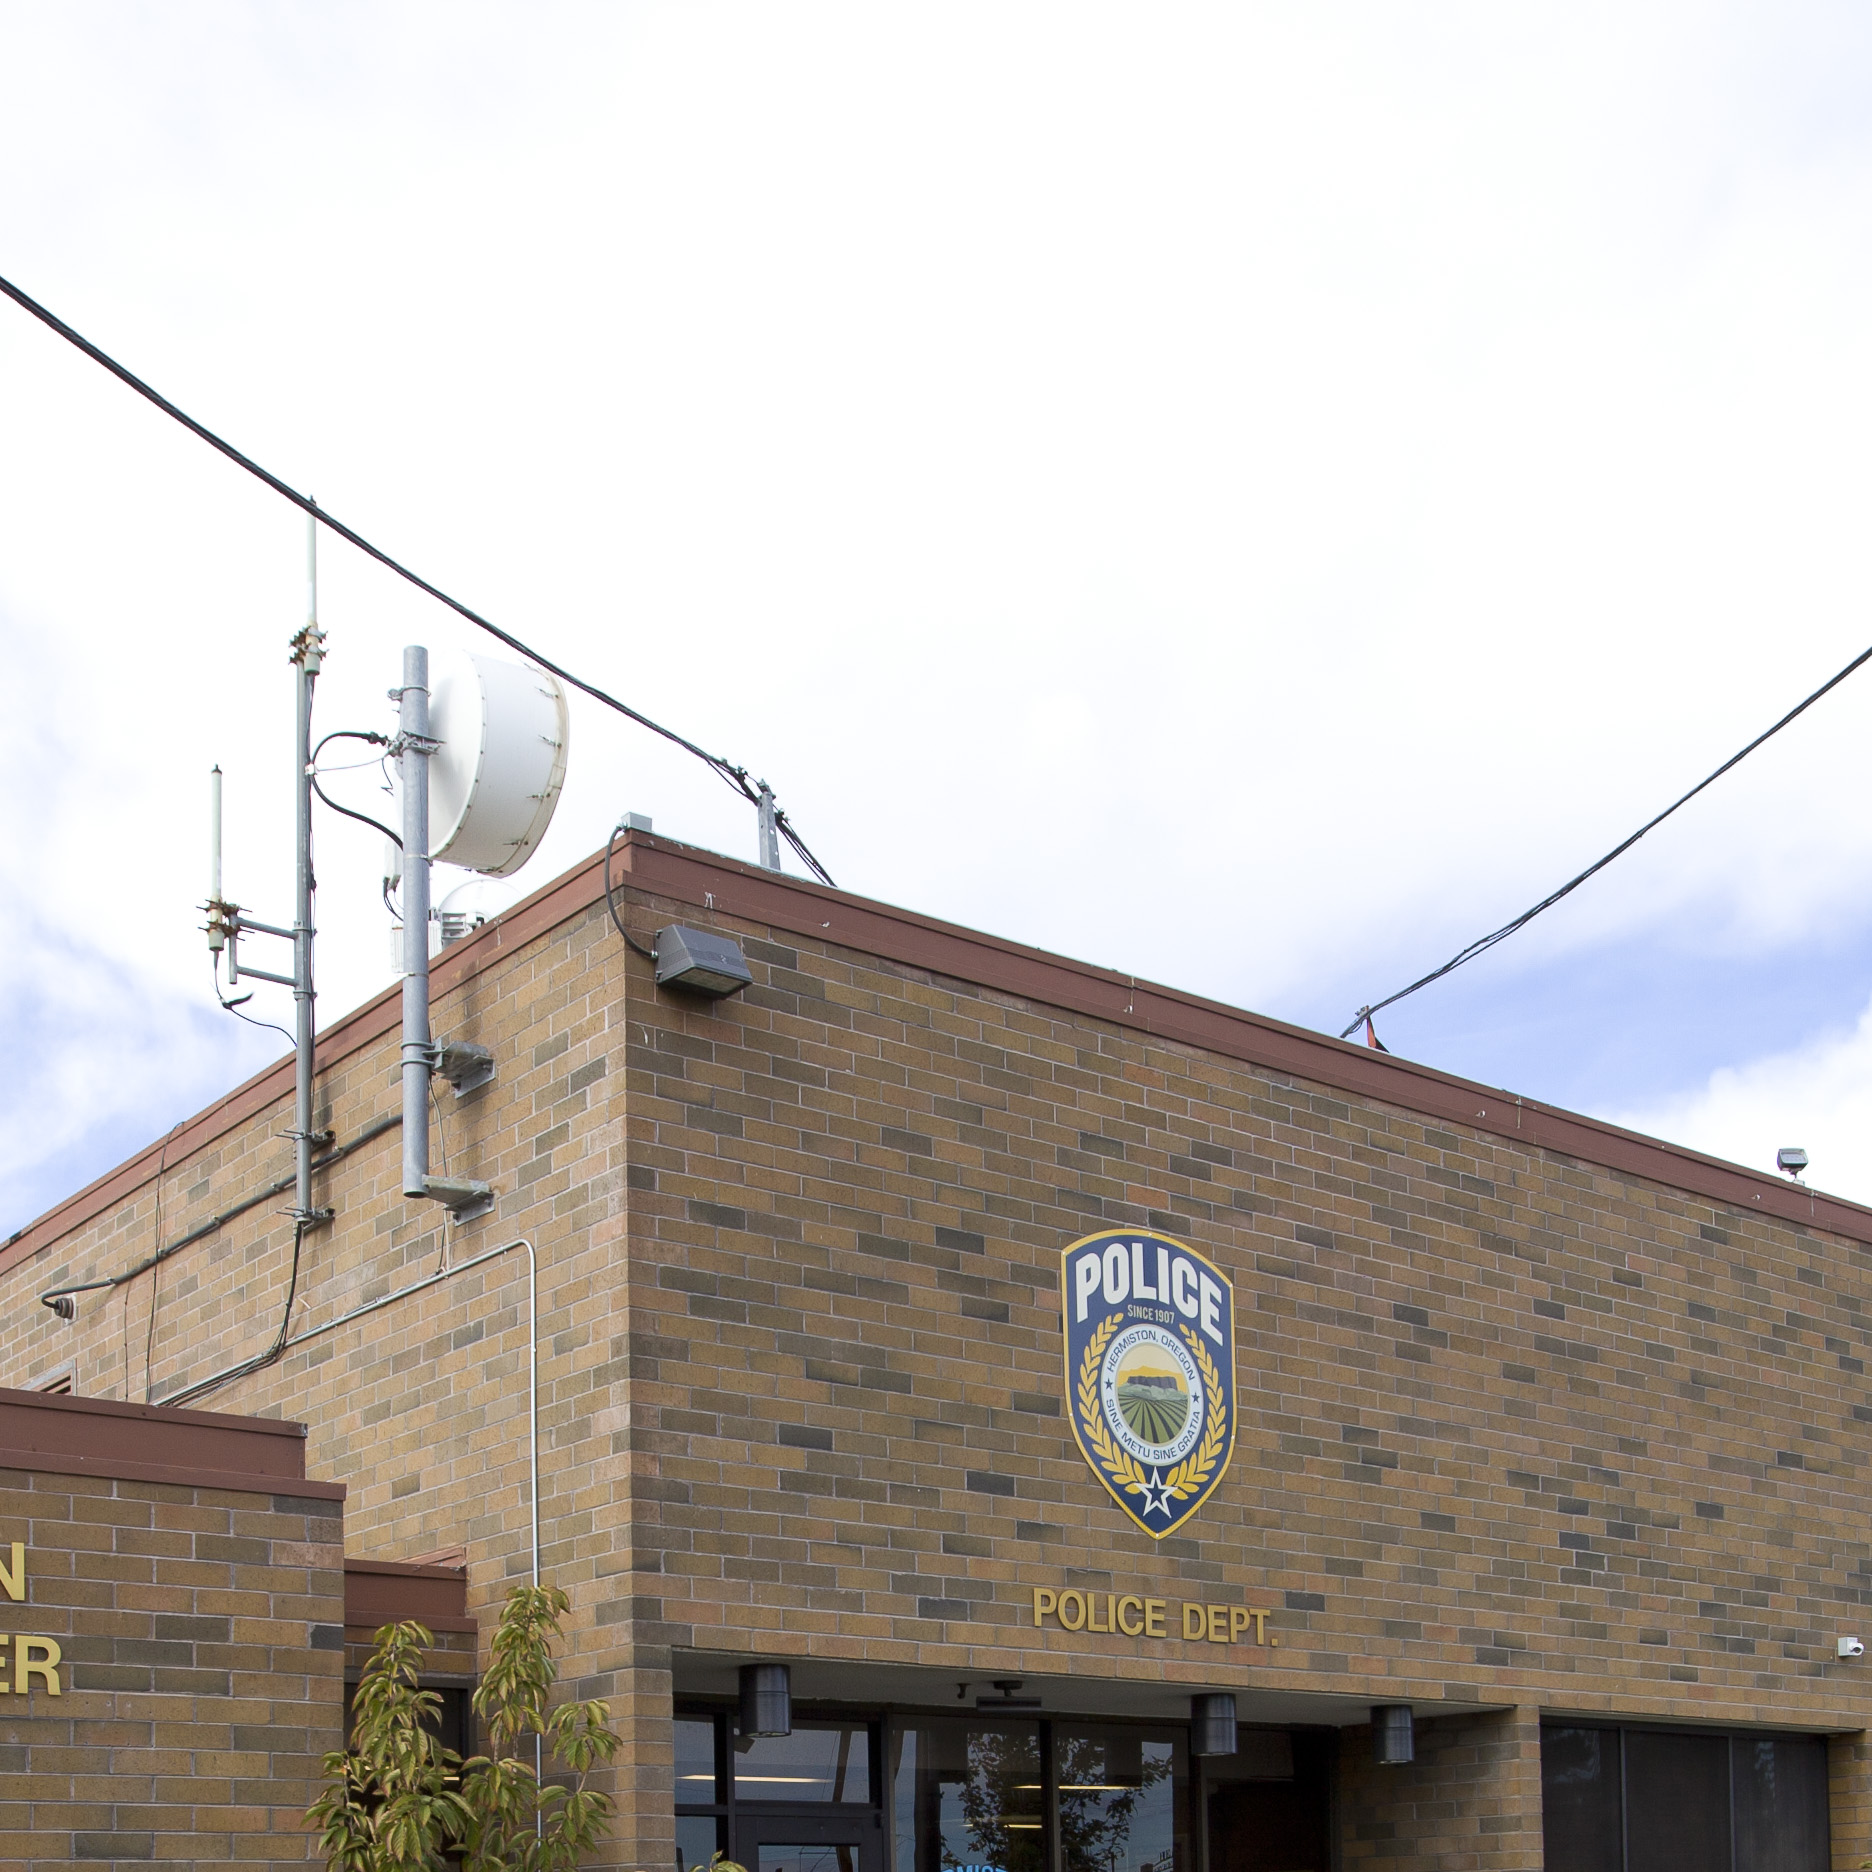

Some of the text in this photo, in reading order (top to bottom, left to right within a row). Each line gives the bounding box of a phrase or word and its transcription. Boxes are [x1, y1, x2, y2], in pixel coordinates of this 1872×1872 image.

[1075, 1242, 1224, 1347] POLICE
[1128, 1304, 1175, 1325] SINCE 1907
[1107, 1329, 1196, 1381] HERMISTON, OREGON
[1106, 1398, 1201, 1460] SINE METU SINE GRATIA
[1033, 1587, 1279, 1647] POLICE DEPT.
